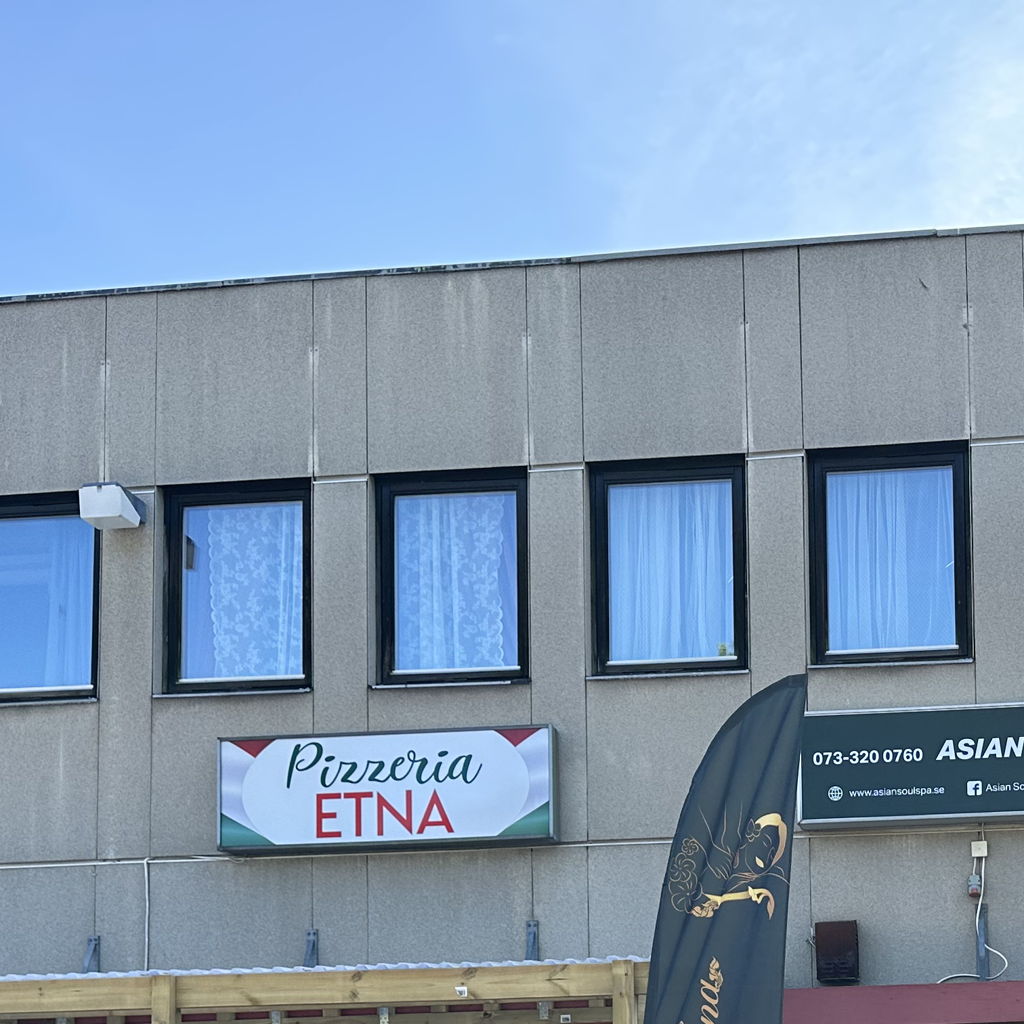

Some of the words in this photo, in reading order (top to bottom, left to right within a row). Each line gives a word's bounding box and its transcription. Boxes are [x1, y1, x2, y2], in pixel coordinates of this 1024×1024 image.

[812, 750, 880, 766] 073-320
[882, 748, 924, 763] 0760
[936, 736, 1024, 761] ASIAN
[285, 740, 483, 790] Pizzeria
[848, 785, 945, 798] www.asiansoulspa.se
[985, 781, 1012, 793] Asian
[315, 788, 455, 839] ETNA
